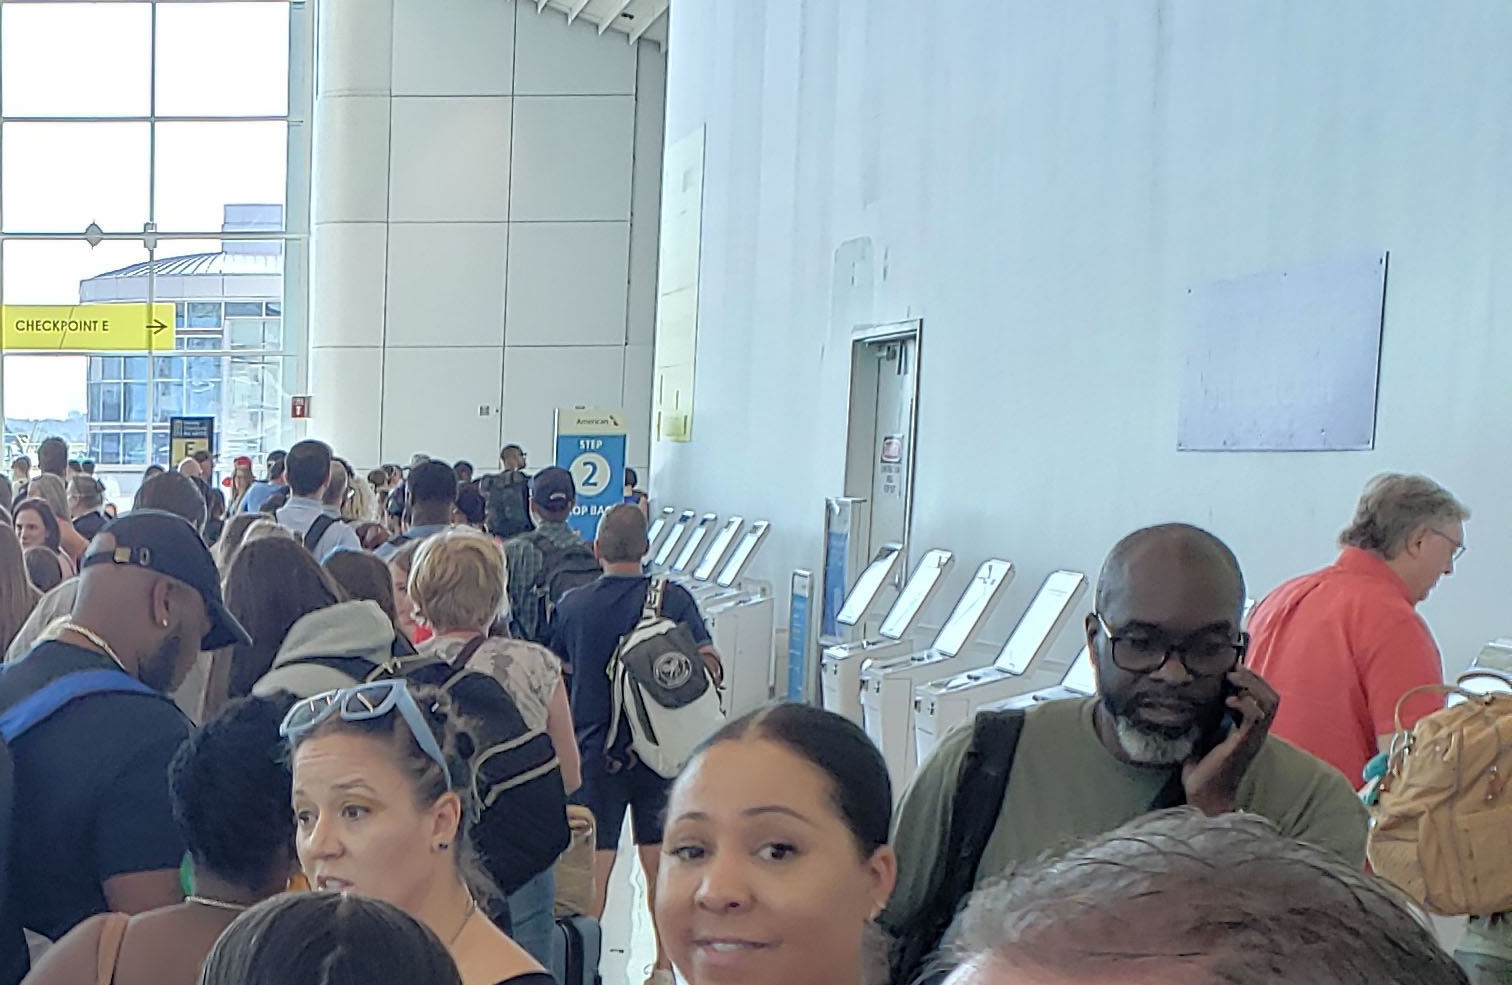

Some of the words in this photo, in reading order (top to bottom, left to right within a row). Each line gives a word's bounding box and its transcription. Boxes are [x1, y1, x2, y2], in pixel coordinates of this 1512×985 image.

[15, 319, 97, 332] CHECKPOINT
[102, 320, 109, 331] E
[579, 439, 602, 449] STEP
[581, 461, 598, 487] 2
[569, 505, 588, 516] OP
